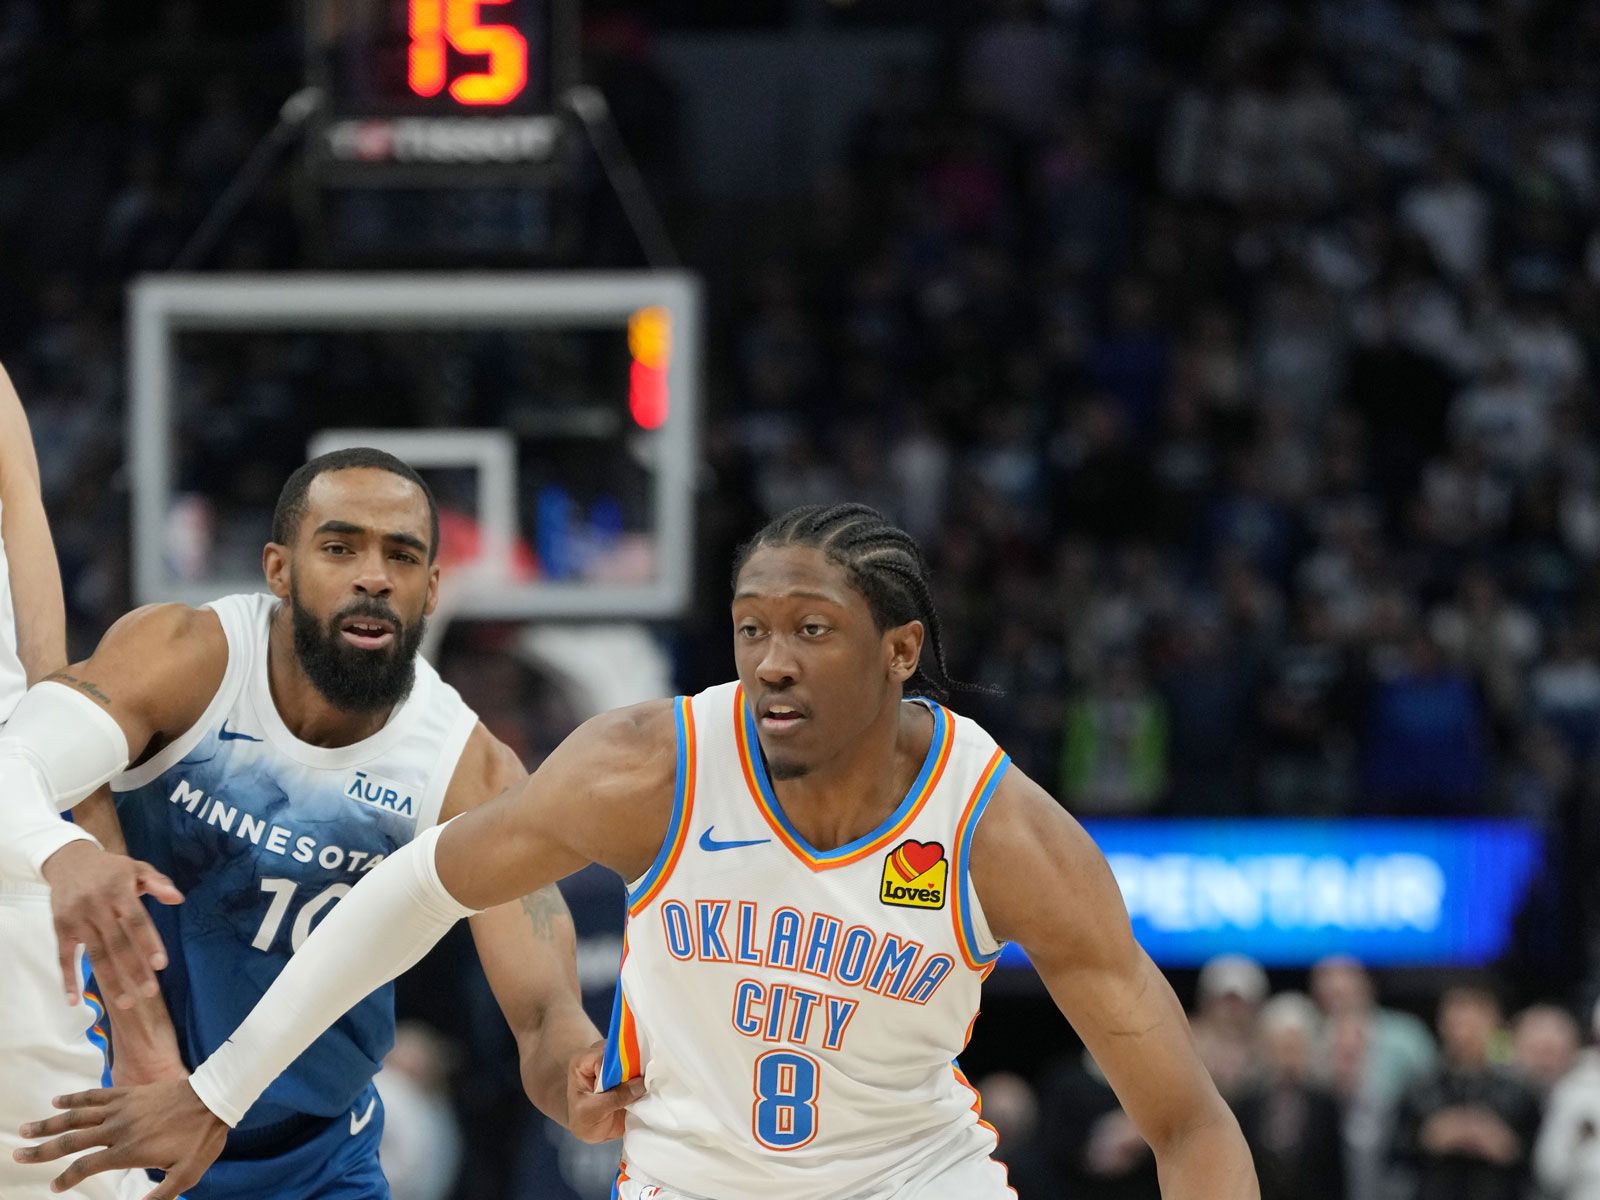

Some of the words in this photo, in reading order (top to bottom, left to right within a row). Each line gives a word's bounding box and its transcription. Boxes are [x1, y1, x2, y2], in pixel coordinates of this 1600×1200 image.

[408, 0, 528, 106] 15
[661, 899, 956, 1006] OKLAHOMA
[731, 978, 859, 1051] CITY
[752, 1048, 820, 1151] 8
